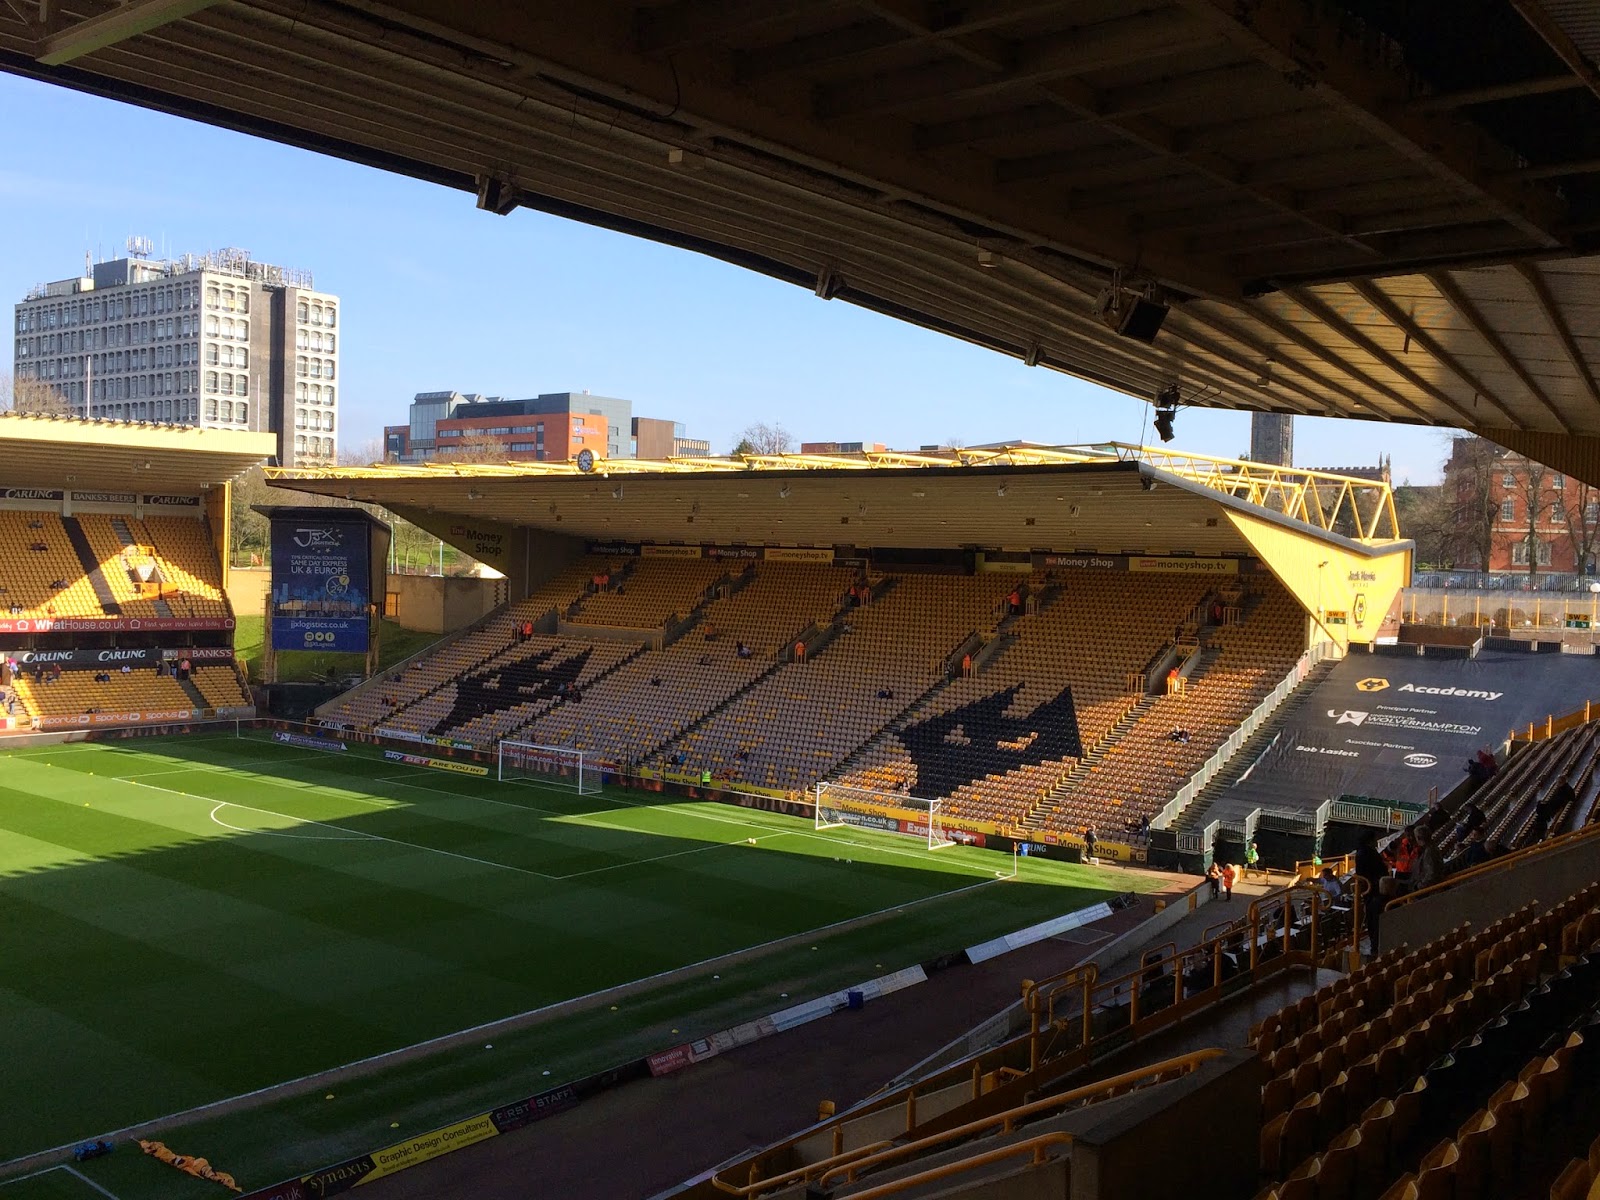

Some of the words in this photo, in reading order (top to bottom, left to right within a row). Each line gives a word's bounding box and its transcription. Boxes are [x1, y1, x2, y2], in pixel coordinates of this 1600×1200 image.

[6, 490, 53, 500] CARLING
[110, 494, 135, 502] BEERS
[150, 496, 194, 505] CARLING
[466, 530, 502, 544] Money
[476, 544, 502, 556] Shop
[1058, 558, 1088, 568] Money
[1090, 558, 1114, 569] Shop
[1157, 560, 1227, 573] moneyshop.tv
[314, 567, 348, 575] EUROPE
[34, 619, 125, 630] WhatHouse.co.uk
[22, 652, 73, 664] CARLING
[98, 650, 146, 661] CARLING
[1398, 684, 1504, 701] Academy
[1376, 704, 1408, 712] Principal
[1410, 706, 1438, 715] Partner
[1367, 717, 1482, 732] WOLVERHAMPTON
[1346, 738, 1382, 746] Associate
[1383, 742, 1414, 750] Partners
[1320, 748, 1360, 758] Laslett
[842, 804, 866, 814] Money
[867, 808, 886, 817] Shop
[958, 824, 978, 832] Shop
[1094, 845, 1118, 858] Shop
[536, 1089, 570, 1108] STAFF
[380, 1149, 412, 1164] Graphic
[414, 1136, 442, 1153] Design
[442, 1118, 490, 1142] Consultancy
[310, 1160, 370, 1196] synaxis
